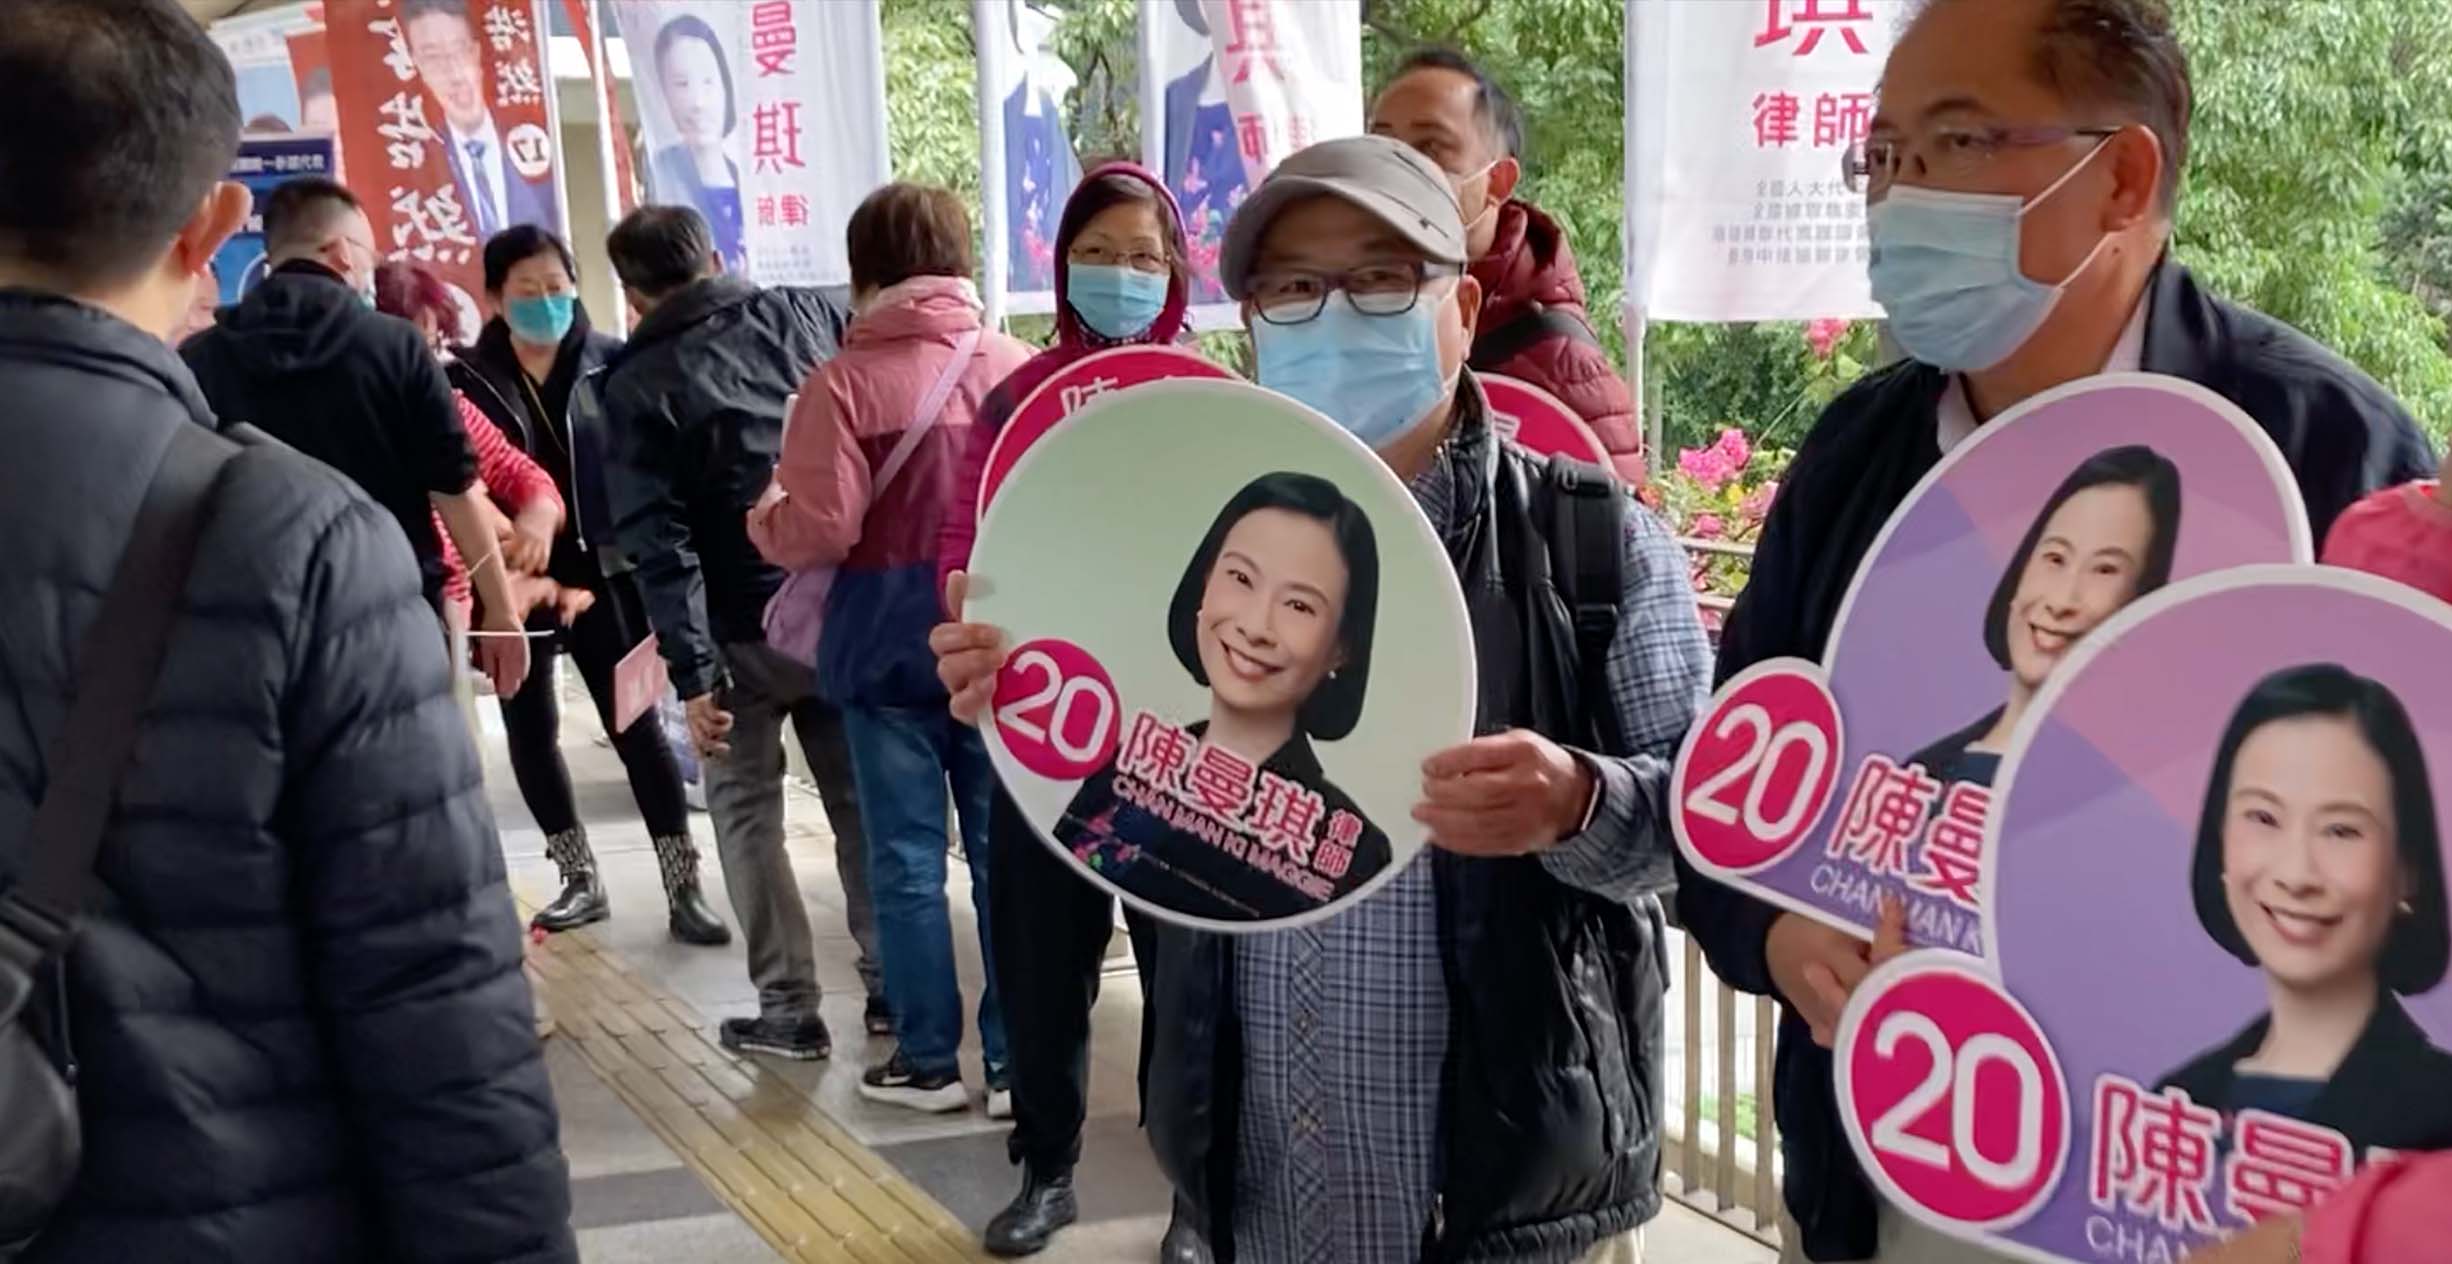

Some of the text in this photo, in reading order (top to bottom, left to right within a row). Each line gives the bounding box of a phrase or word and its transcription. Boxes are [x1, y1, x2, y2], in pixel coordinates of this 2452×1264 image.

[1752, 90, 1873, 147] 律師
[1000, 650, 1114, 763] 20
[1686, 703, 1827, 843] 20
[1112, 774, 1176, 822] CHAN
[1169, 804, 1224, 848] MAN
[1222, 829, 1249, 860] KI
[1246, 841, 1335, 902] MAGGIE
[1116, 710, 1326, 865] 陳曼琪
[1312, 808, 1363, 879] 律師
[1872, 1009, 2044, 1190] 20
[2092, 1072, 2400, 1240] 陳曼
